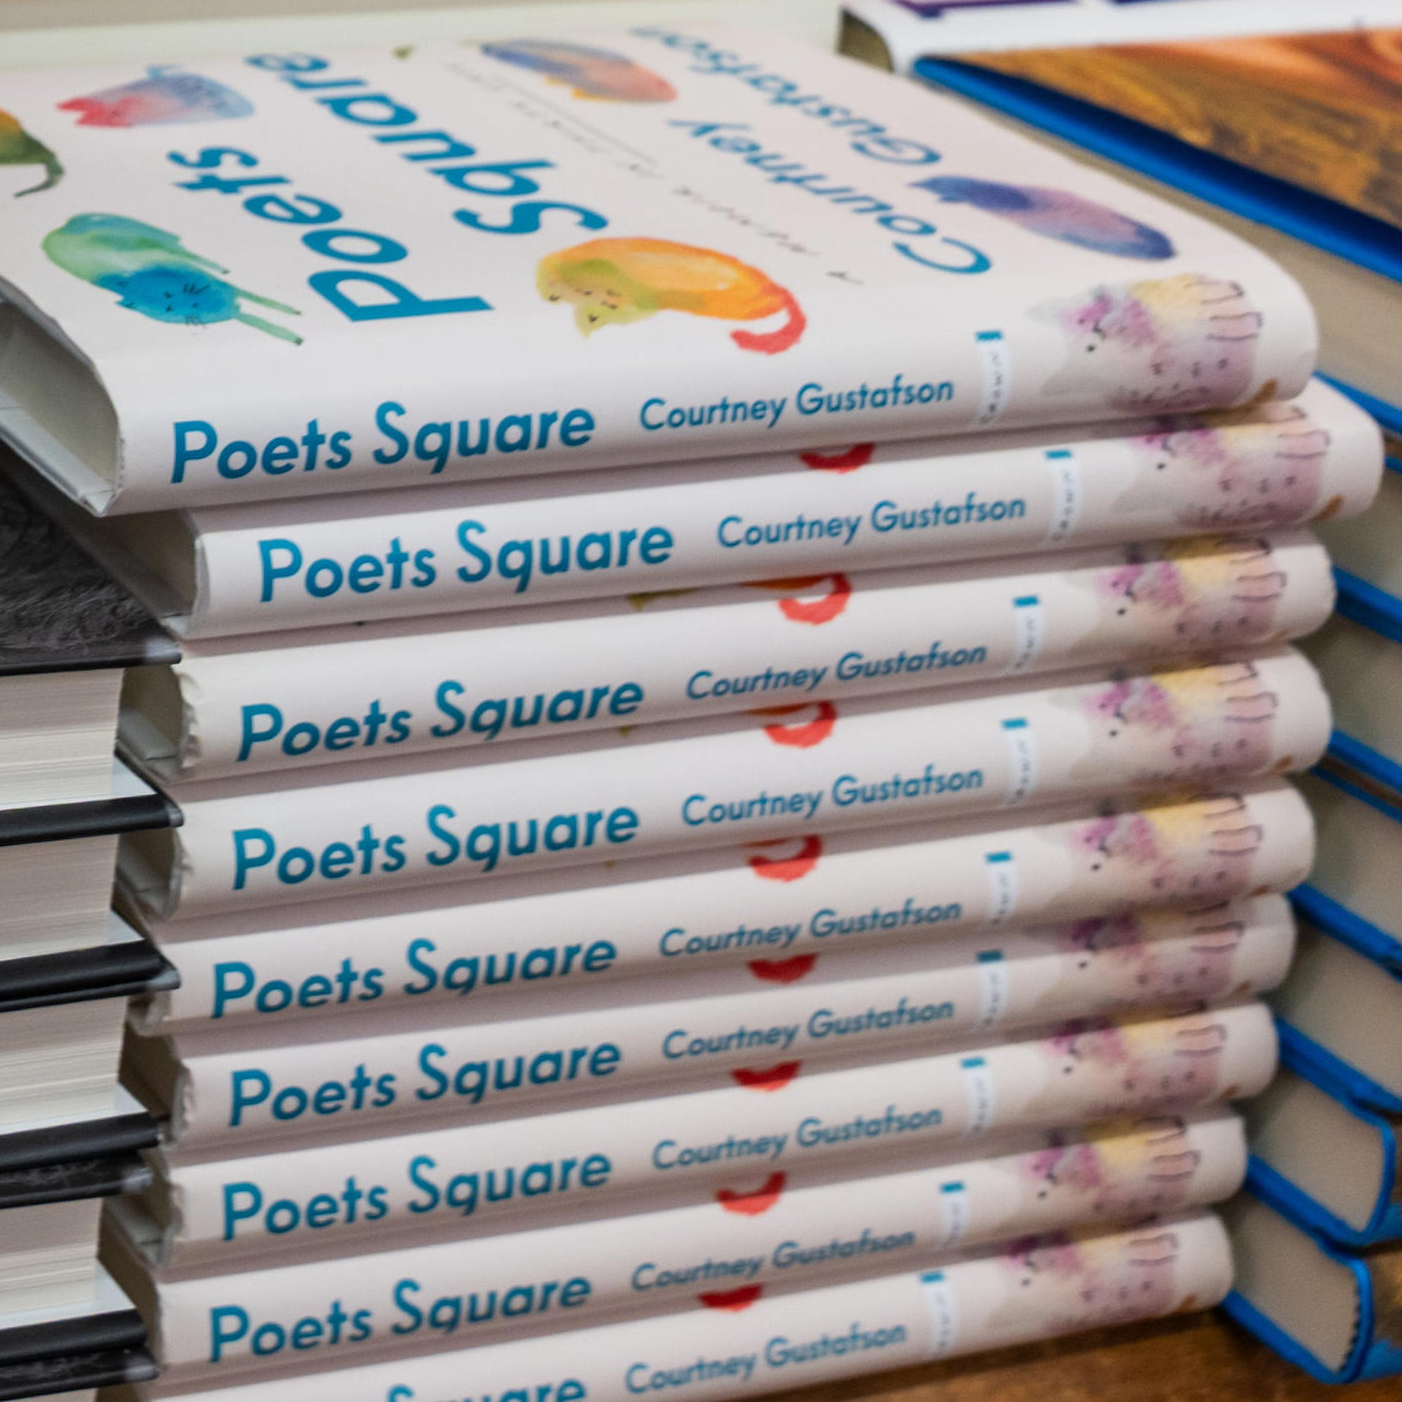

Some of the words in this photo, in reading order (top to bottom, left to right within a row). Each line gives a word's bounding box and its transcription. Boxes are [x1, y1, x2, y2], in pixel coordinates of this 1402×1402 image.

[244, 51, 611, 237] Square
[668, 117, 994, 277] Courtney
[166, 145, 495, 324] Poets
[170, 416, 354, 485] Poets
[371, 399, 597, 476] Square
[638, 395, 788, 432] Courtney
[794, 373, 955, 417] Gustafson
[256, 536, 438, 604] Poets
[455, 518, 676, 595] Square
[716, 512, 862, 550] Courtney
[870, 491, 1026, 535] Gustafson
[236, 698, 413, 763] Poets
[430, 679, 645, 741] Square
[685, 667, 829, 701] Courtney
[834, 641, 988, 684] Gustafson
[231, 823, 408, 892] Poets
[425, 803, 641, 873] Square
[681, 789, 824, 828] Courtney
[830, 763, 985, 809] Gustafson
[212, 956, 385, 1022] Poets
[403, 937, 618, 997] Square
[659, 922, 801, 959] Courtney
[808, 899, 963, 939] Gustafson
[228, 1063, 398, 1129] Poets
[415, 1042, 622, 1106] Square
[662, 1023, 800, 1061] Courtney
[807, 999, 954, 1040] Gustafson
[222, 1176, 390, 1243] Poets
[407, 1153, 613, 1216] Square
[652, 1131, 790, 1171] Courtney
[795, 1105, 944, 1147] Gustafson
[209, 1300, 374, 1365] Poets
[391, 1276, 593, 1337] Square
